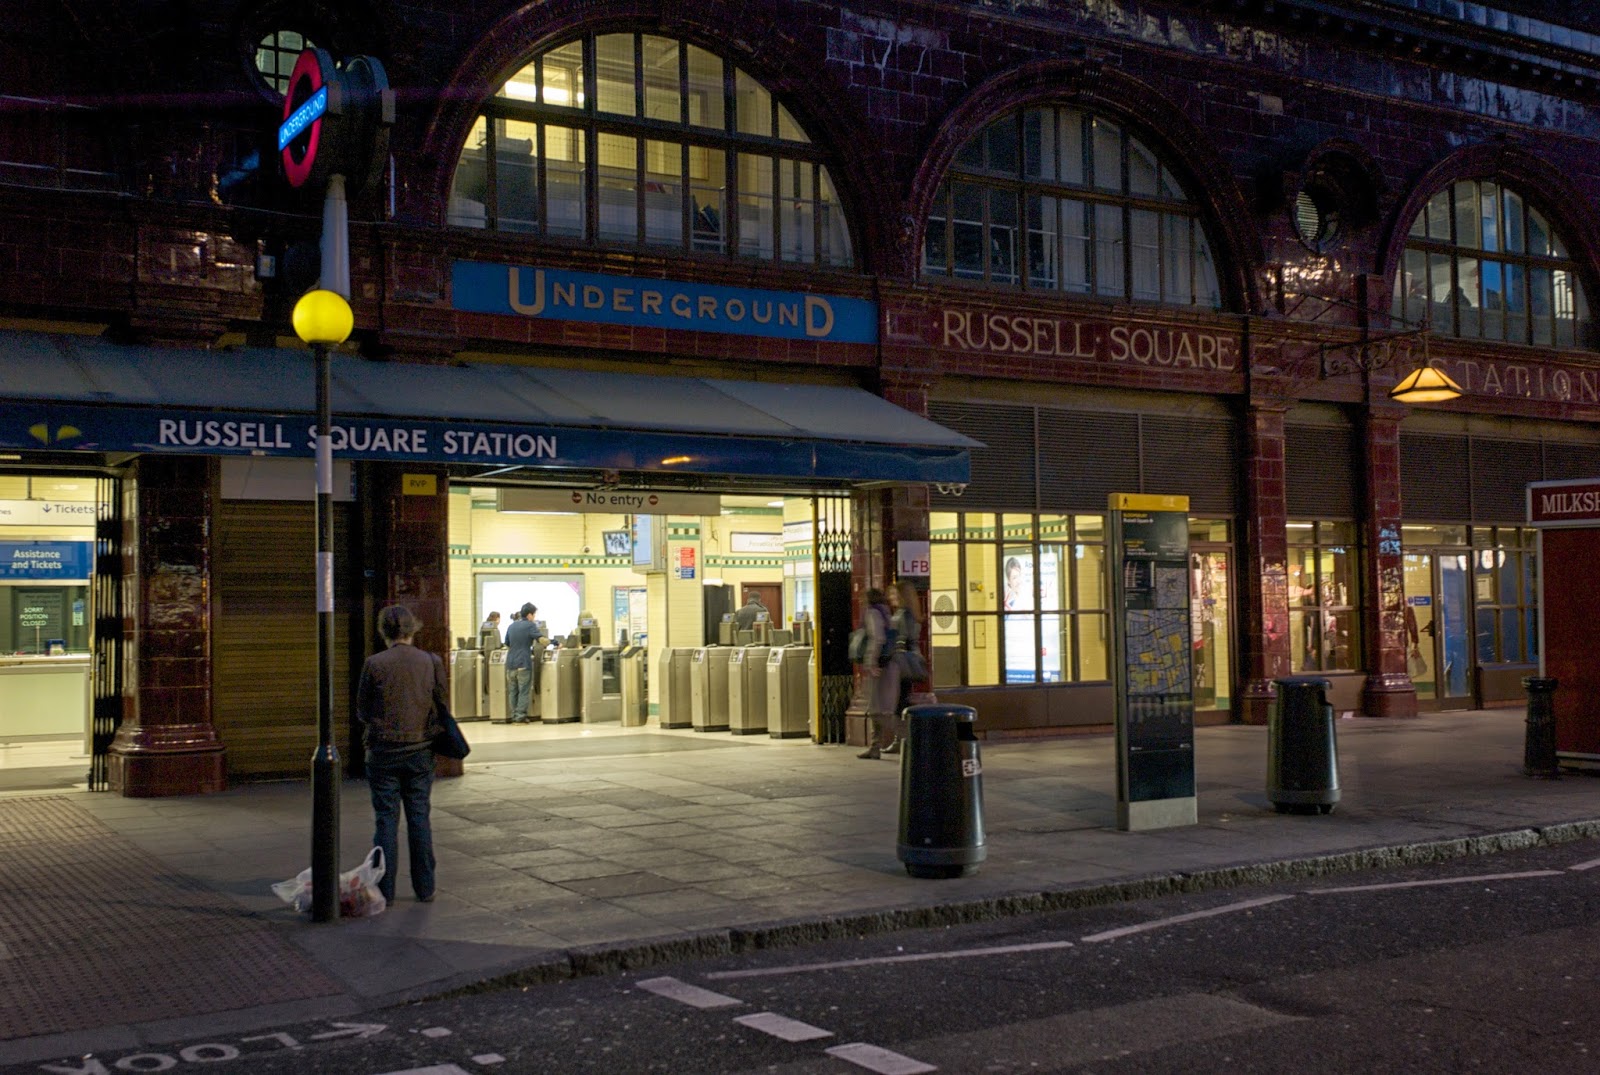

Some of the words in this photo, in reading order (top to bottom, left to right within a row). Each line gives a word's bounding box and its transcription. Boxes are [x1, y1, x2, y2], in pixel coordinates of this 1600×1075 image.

[281, 94, 325, 143] UNDERGROUND
[943, 310, 1096, 357] RUSSELL
[1110, 326, 1235, 371] SQUARE
[159, 418, 291, 449] RUSSELL
[306, 425, 428, 453] SQUARE
[443, 430, 557, 458] STATION
[410, 480, 427, 488] RVP
[586, 492, 605, 504] No
[610, 493, 644, 508] entry
[54, 504, 95, 514] Tickets
[13, 550, 61, 559] Assistance
[11, 560, 29, 569] and
[31, 560, 62, 569] Tickets
[902, 560, 929, 573] LFB
